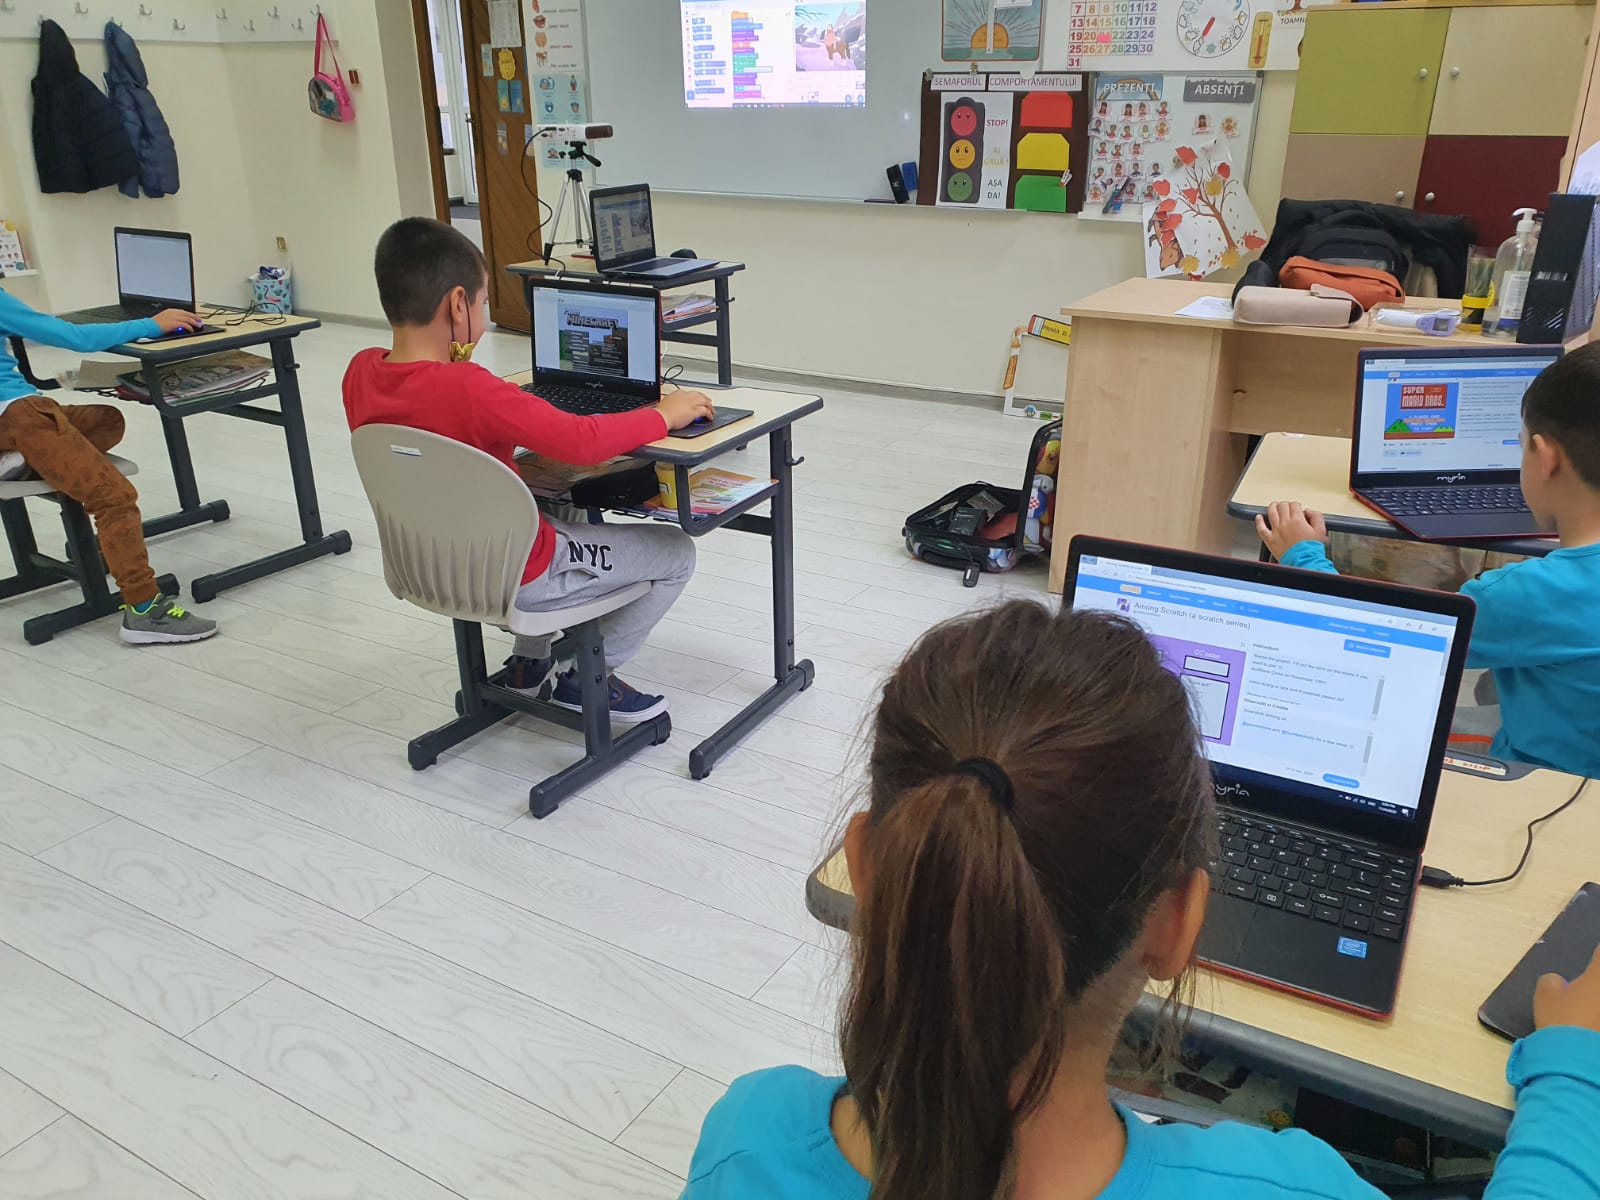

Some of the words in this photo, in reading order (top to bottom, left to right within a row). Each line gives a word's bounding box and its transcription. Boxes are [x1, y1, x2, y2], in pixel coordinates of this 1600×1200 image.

[1075, 5, 1081, 14] 7
[1089, 5, 1095, 13] 8
[1103, 4, 1110, 13] 9
[1115, 4, 1127, 12] 10
[1129, 3, 1141, 12] 11
[1144, 2, 1157, 11] 12
[1071, 18, 1084, 27] 13
[1086, 18, 1097, 27] 14
[1099, 17, 1111, 26] 15
[1115, 17, 1126, 26] 16
[1128, 17, 1140, 26] 17
[1143, 16, 1155, 25] 18
[1280, 16, 1305, 24] TOAMN
[1070, 32, 1082, 41] 19
[1084, 31, 1096, 40] 20
[1112, 31, 1125, 39] 22
[1126, 30, 1139, 40] 23
[1141, 30, 1154, 39] 24
[1069, 45, 1082, 54] 25
[1083, 45, 1095, 53] 26
[1097, 44, 1109, 53] 27
[1111, 44, 1123, 53] 28
[1126, 44, 1138, 53] 29
[1140, 44, 1153, 52] 30
[1068, 58, 1080, 67] 31
[934, 77, 983, 86] SEMAFORUL
[989, 77, 1077, 87] COMPORTAMENTULUI
[986, 119, 1009, 127] STOP!
[568, 540, 613, 571] NYC
[1133, 602, 1159, 613] Among
[1160, 606, 1188, 617] Scratch
[1197, 614, 1224, 625] scratch
[1225, 619, 1251, 630] series)
